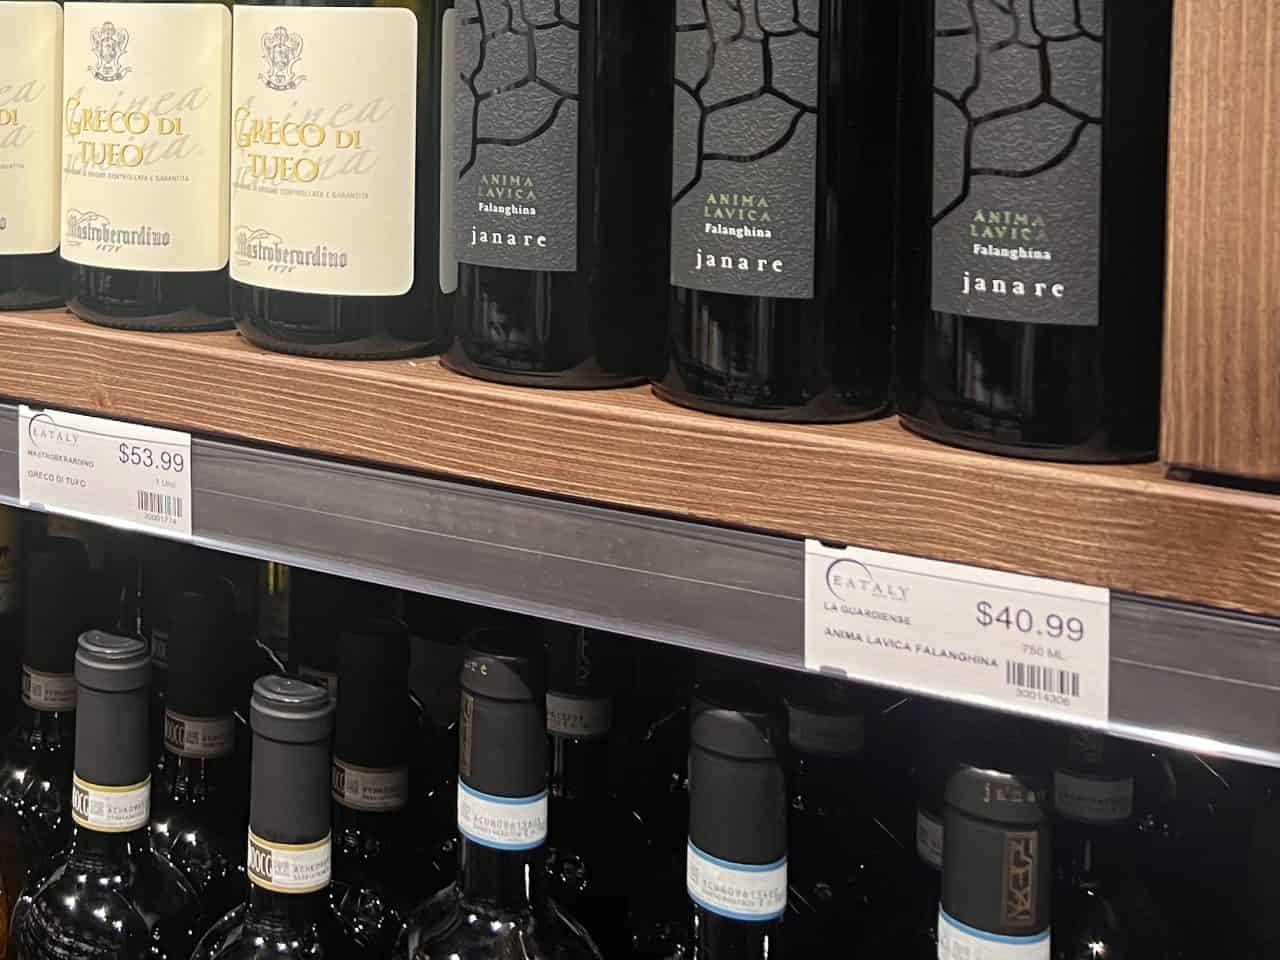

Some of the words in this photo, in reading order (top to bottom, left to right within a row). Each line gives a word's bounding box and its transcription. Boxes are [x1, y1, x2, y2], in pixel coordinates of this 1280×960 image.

[64, 95, 150, 137] GRECO
[157, 116, 185, 136] DI
[233, 105, 326, 149] GRECO
[335, 128, 361, 149] DI
[77, 140, 145, 168] TUFO
[247, 152, 320, 183] TUFO
[478, 202, 536, 217] Falanghina
[706, 192, 769, 209] ANIMA
[704, 206, 771, 222] LAVICA
[471, 225, 547, 248] janare
[704, 222, 772, 239] Falanghina
[695, 248, 784, 272] janare
[973, 243, 1052, 261] Falanghina
[961, 271, 1065, 298] janare
[118, 442, 185, 473] $53.99
[832, 574, 910, 600] EATALY
[823, 601, 838, 613] LA
[840, 604, 912, 626] GUARDIENSE
[976, 600, 1085, 642] $40.99
[823, 627, 862, 643] ANIMA
[867, 634, 912, 652] LAVICA
[915, 644, 999, 668] FALANGHINA
